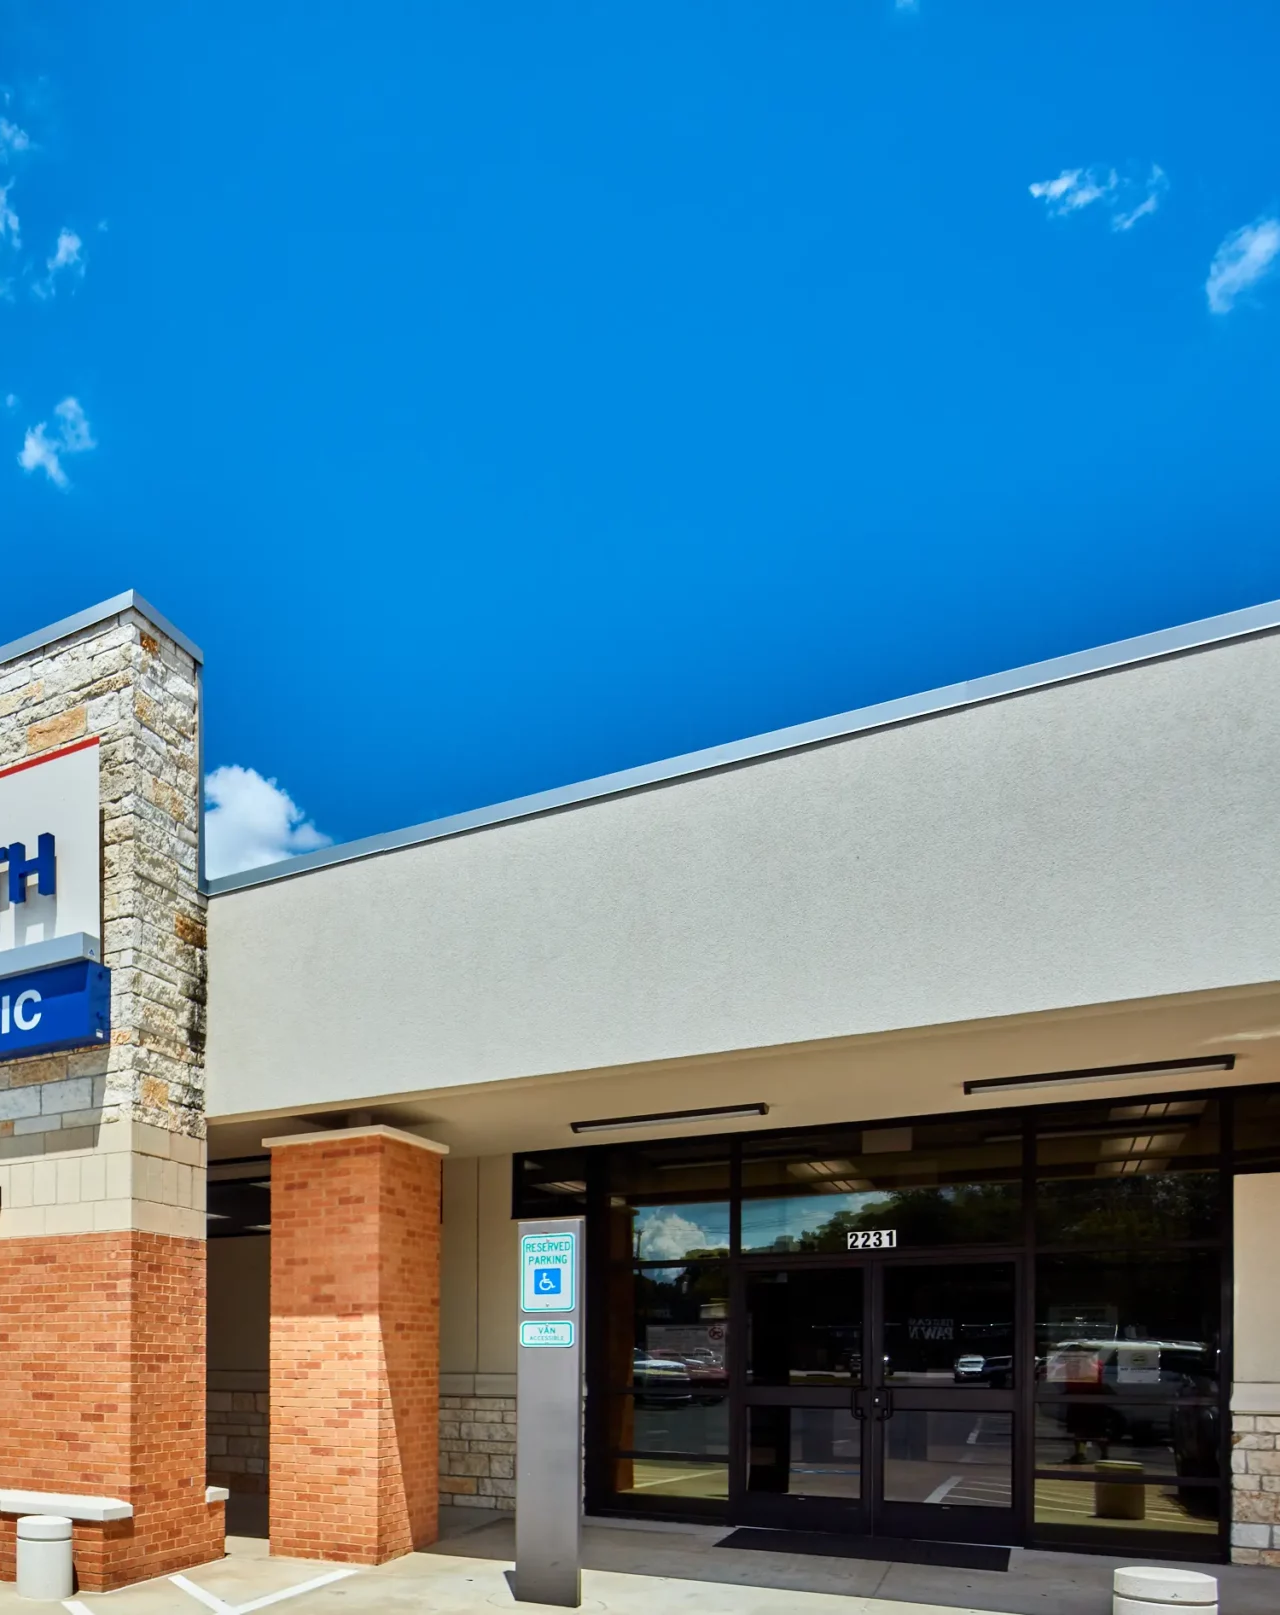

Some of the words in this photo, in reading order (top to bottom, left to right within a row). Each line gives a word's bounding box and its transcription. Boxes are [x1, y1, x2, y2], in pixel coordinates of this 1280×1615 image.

[849, 1231, 893, 1248] 2231
[525, 1242, 570, 1253] RESERVED
[528, 1255, 567, 1265] PARKING
